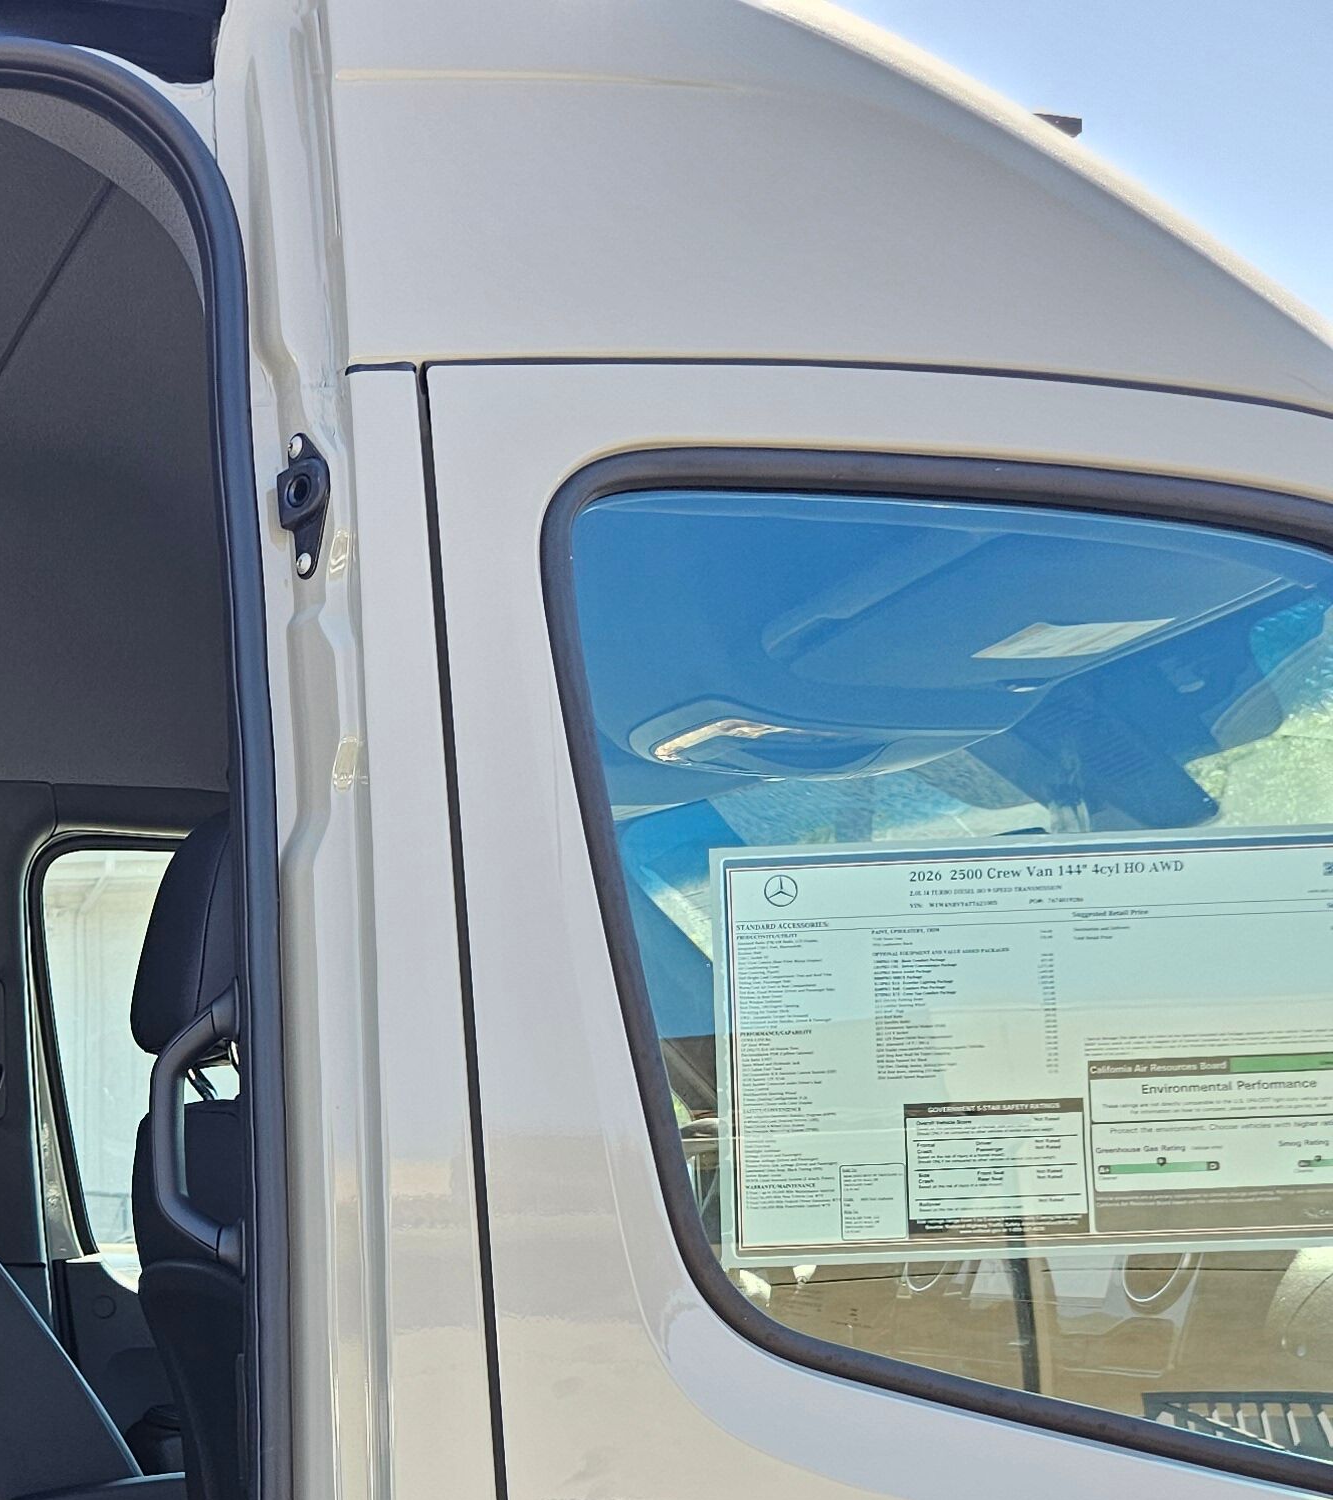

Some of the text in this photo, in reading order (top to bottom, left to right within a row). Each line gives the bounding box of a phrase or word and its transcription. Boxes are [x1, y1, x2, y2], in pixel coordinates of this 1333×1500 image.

[909, 860, 1184, 882] 2026 2500 Crew Van 144" 4cyl HO AWD
[736, 923, 776, 931] STANDARD
[1090, 1060, 1228, 1075] California Air Resources Board
[1141, 1080, 1317, 1094] Environmental Performance
[927, 1105, 976, 1113] GOVERNMENT
[1002, 1103, 1029, 1111] SAFETY
[1303, 1138, 1330, 1147] Rating
[1095, 1146, 1141, 1154] Greenhouse
[1161, 1144, 1186, 1152] Rating
